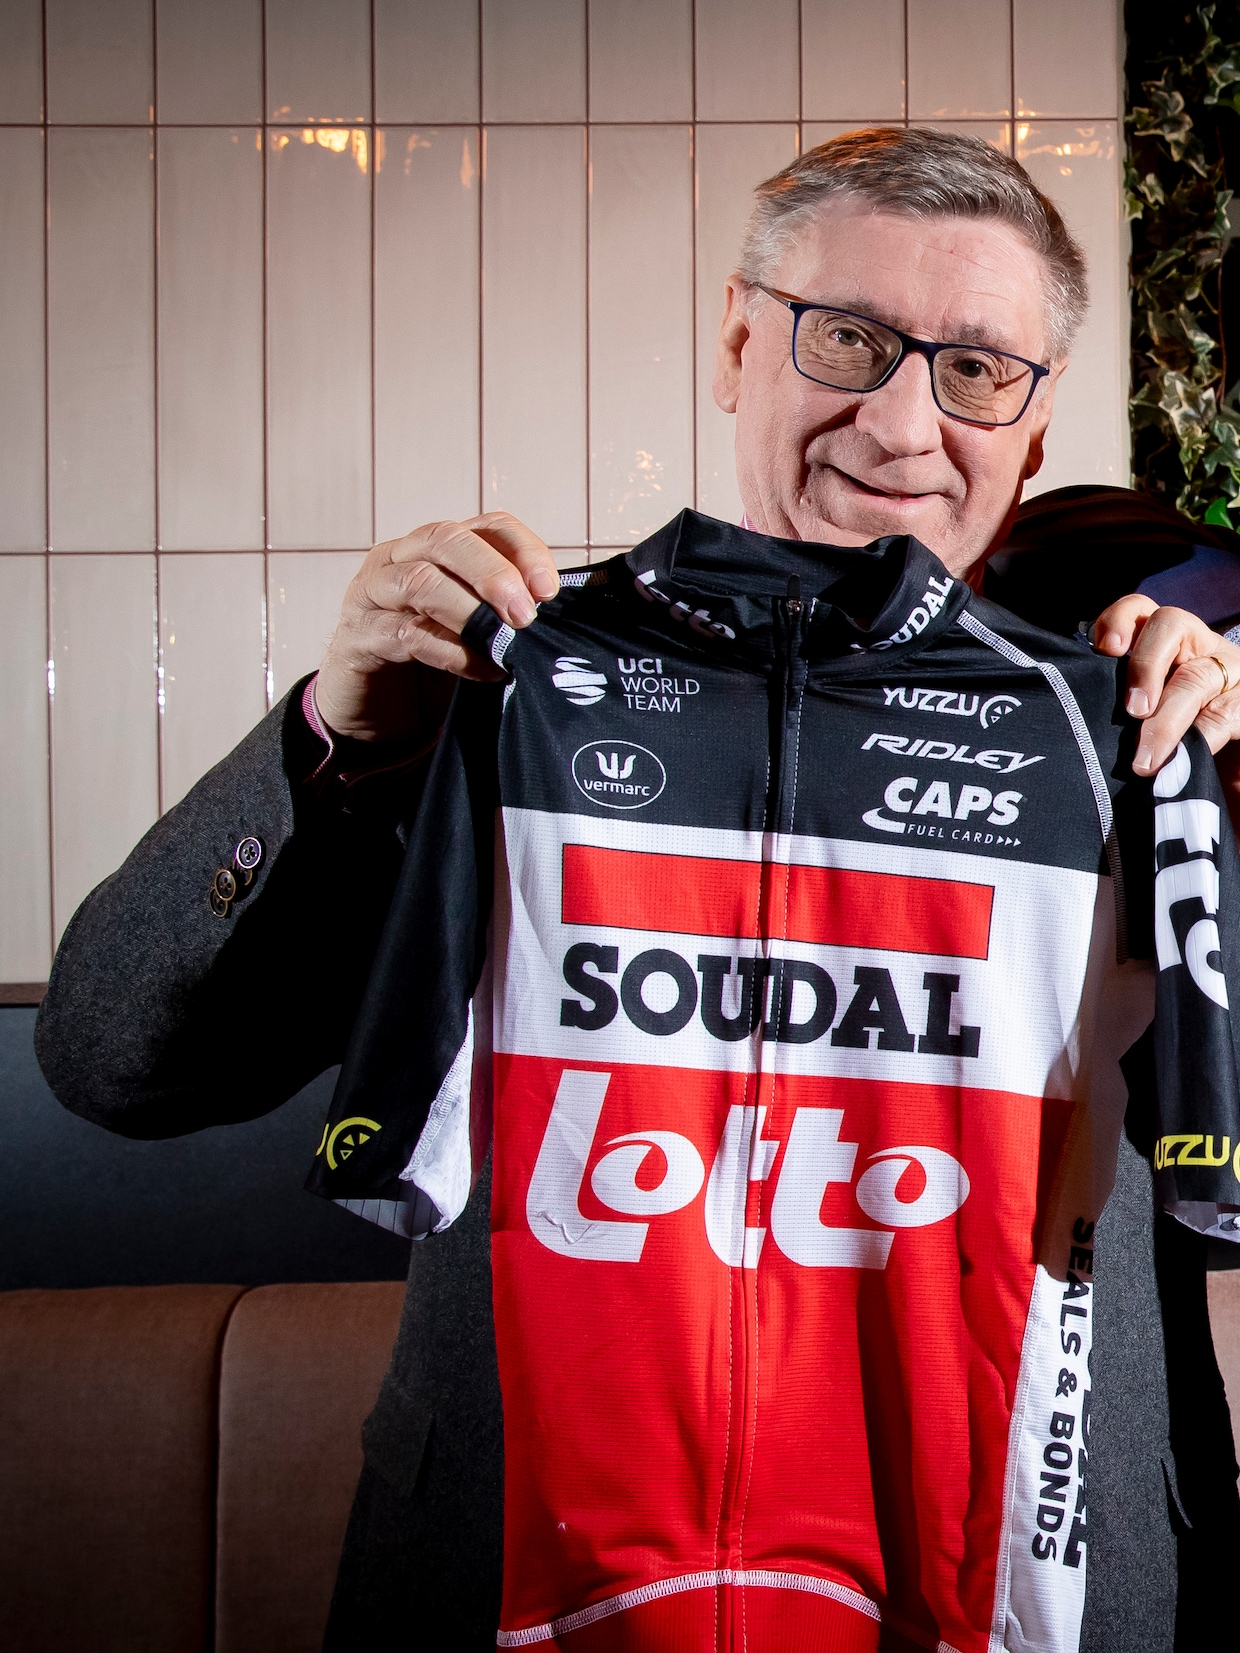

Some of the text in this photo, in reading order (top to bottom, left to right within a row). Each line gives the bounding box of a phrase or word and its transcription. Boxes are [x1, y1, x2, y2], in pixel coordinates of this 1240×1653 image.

[617, 657, 662, 675] UCI
[620, 676, 700, 695] WORLD
[623, 693, 681, 713] TEAM
[882, 686, 980, 717] YUZZU
[861, 732, 1047, 774] RIDLEY
[583, 778, 651, 797] vermarc
[883, 776, 1024, 827] CAPS
[907, 823, 995, 845] FUEL CARD
[560, 942, 981, 1058] SOUDAL
[1060, 1216, 1095, 1356] SEALS
[1055, 1367, 1078, 1398] &
[1031, 1410, 1076, 1562] BONDS
